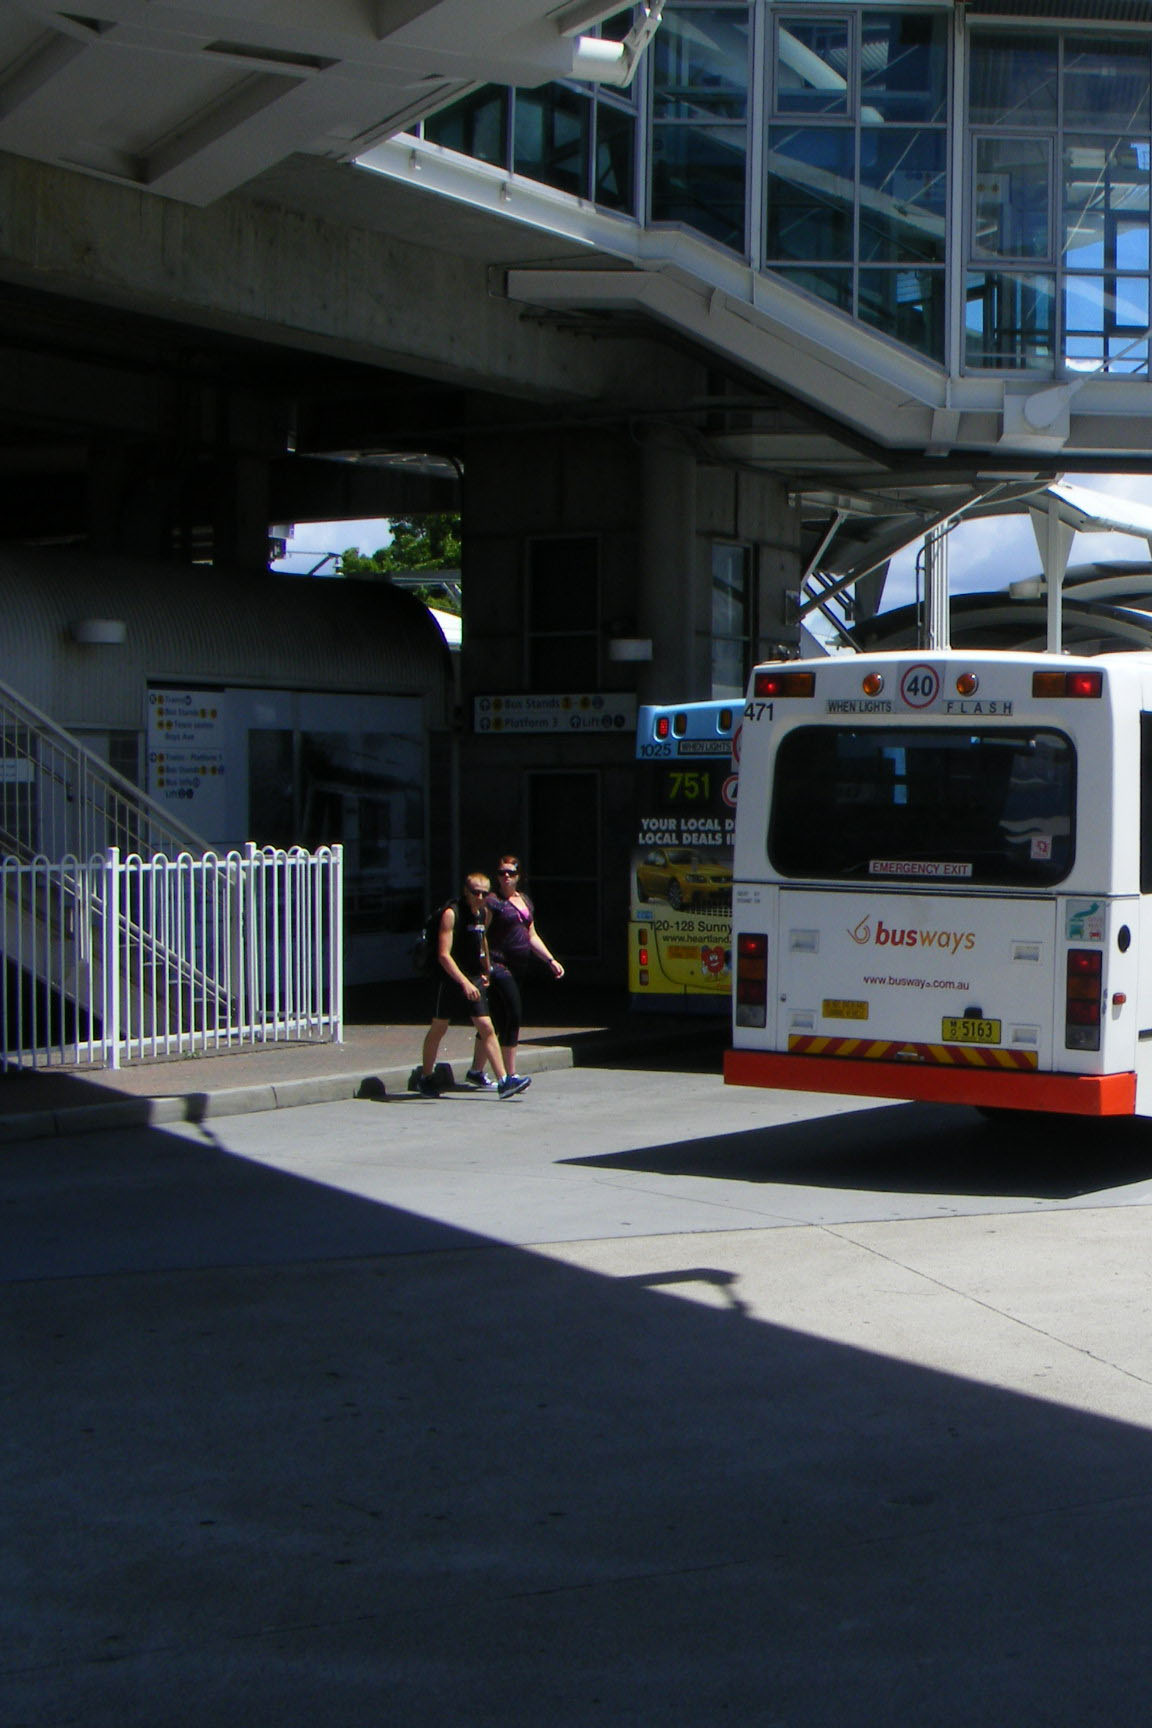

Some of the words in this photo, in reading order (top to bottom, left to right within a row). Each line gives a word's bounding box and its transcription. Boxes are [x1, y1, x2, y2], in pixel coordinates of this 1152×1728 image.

[906, 675, 933, 696] 40
[526, 698, 560, 709] Stands
[828, 701, 856, 712] WHEN
[859, 701, 892, 713] LIGHTS
[947, 702, 1012, 714] FLASH
[744, 702, 774, 721] 471
[504, 716, 549, 729] Platform
[640, 743, 672, 757] 1025
[669, 772, 710, 799] 751
[641, 818, 677, 830] YOUR
[680, 818, 721, 830] LOCAL
[638, 832, 679, 845] LOCAL
[682, 832, 723, 845] DEALS
[872, 862, 940, 874] EMERGENCY
[943, 864, 969, 875] EXIT
[649, 920, 695, 931] 120-128
[875, 920, 976, 955] busways
[962, 1021, 992, 1038] 5163
